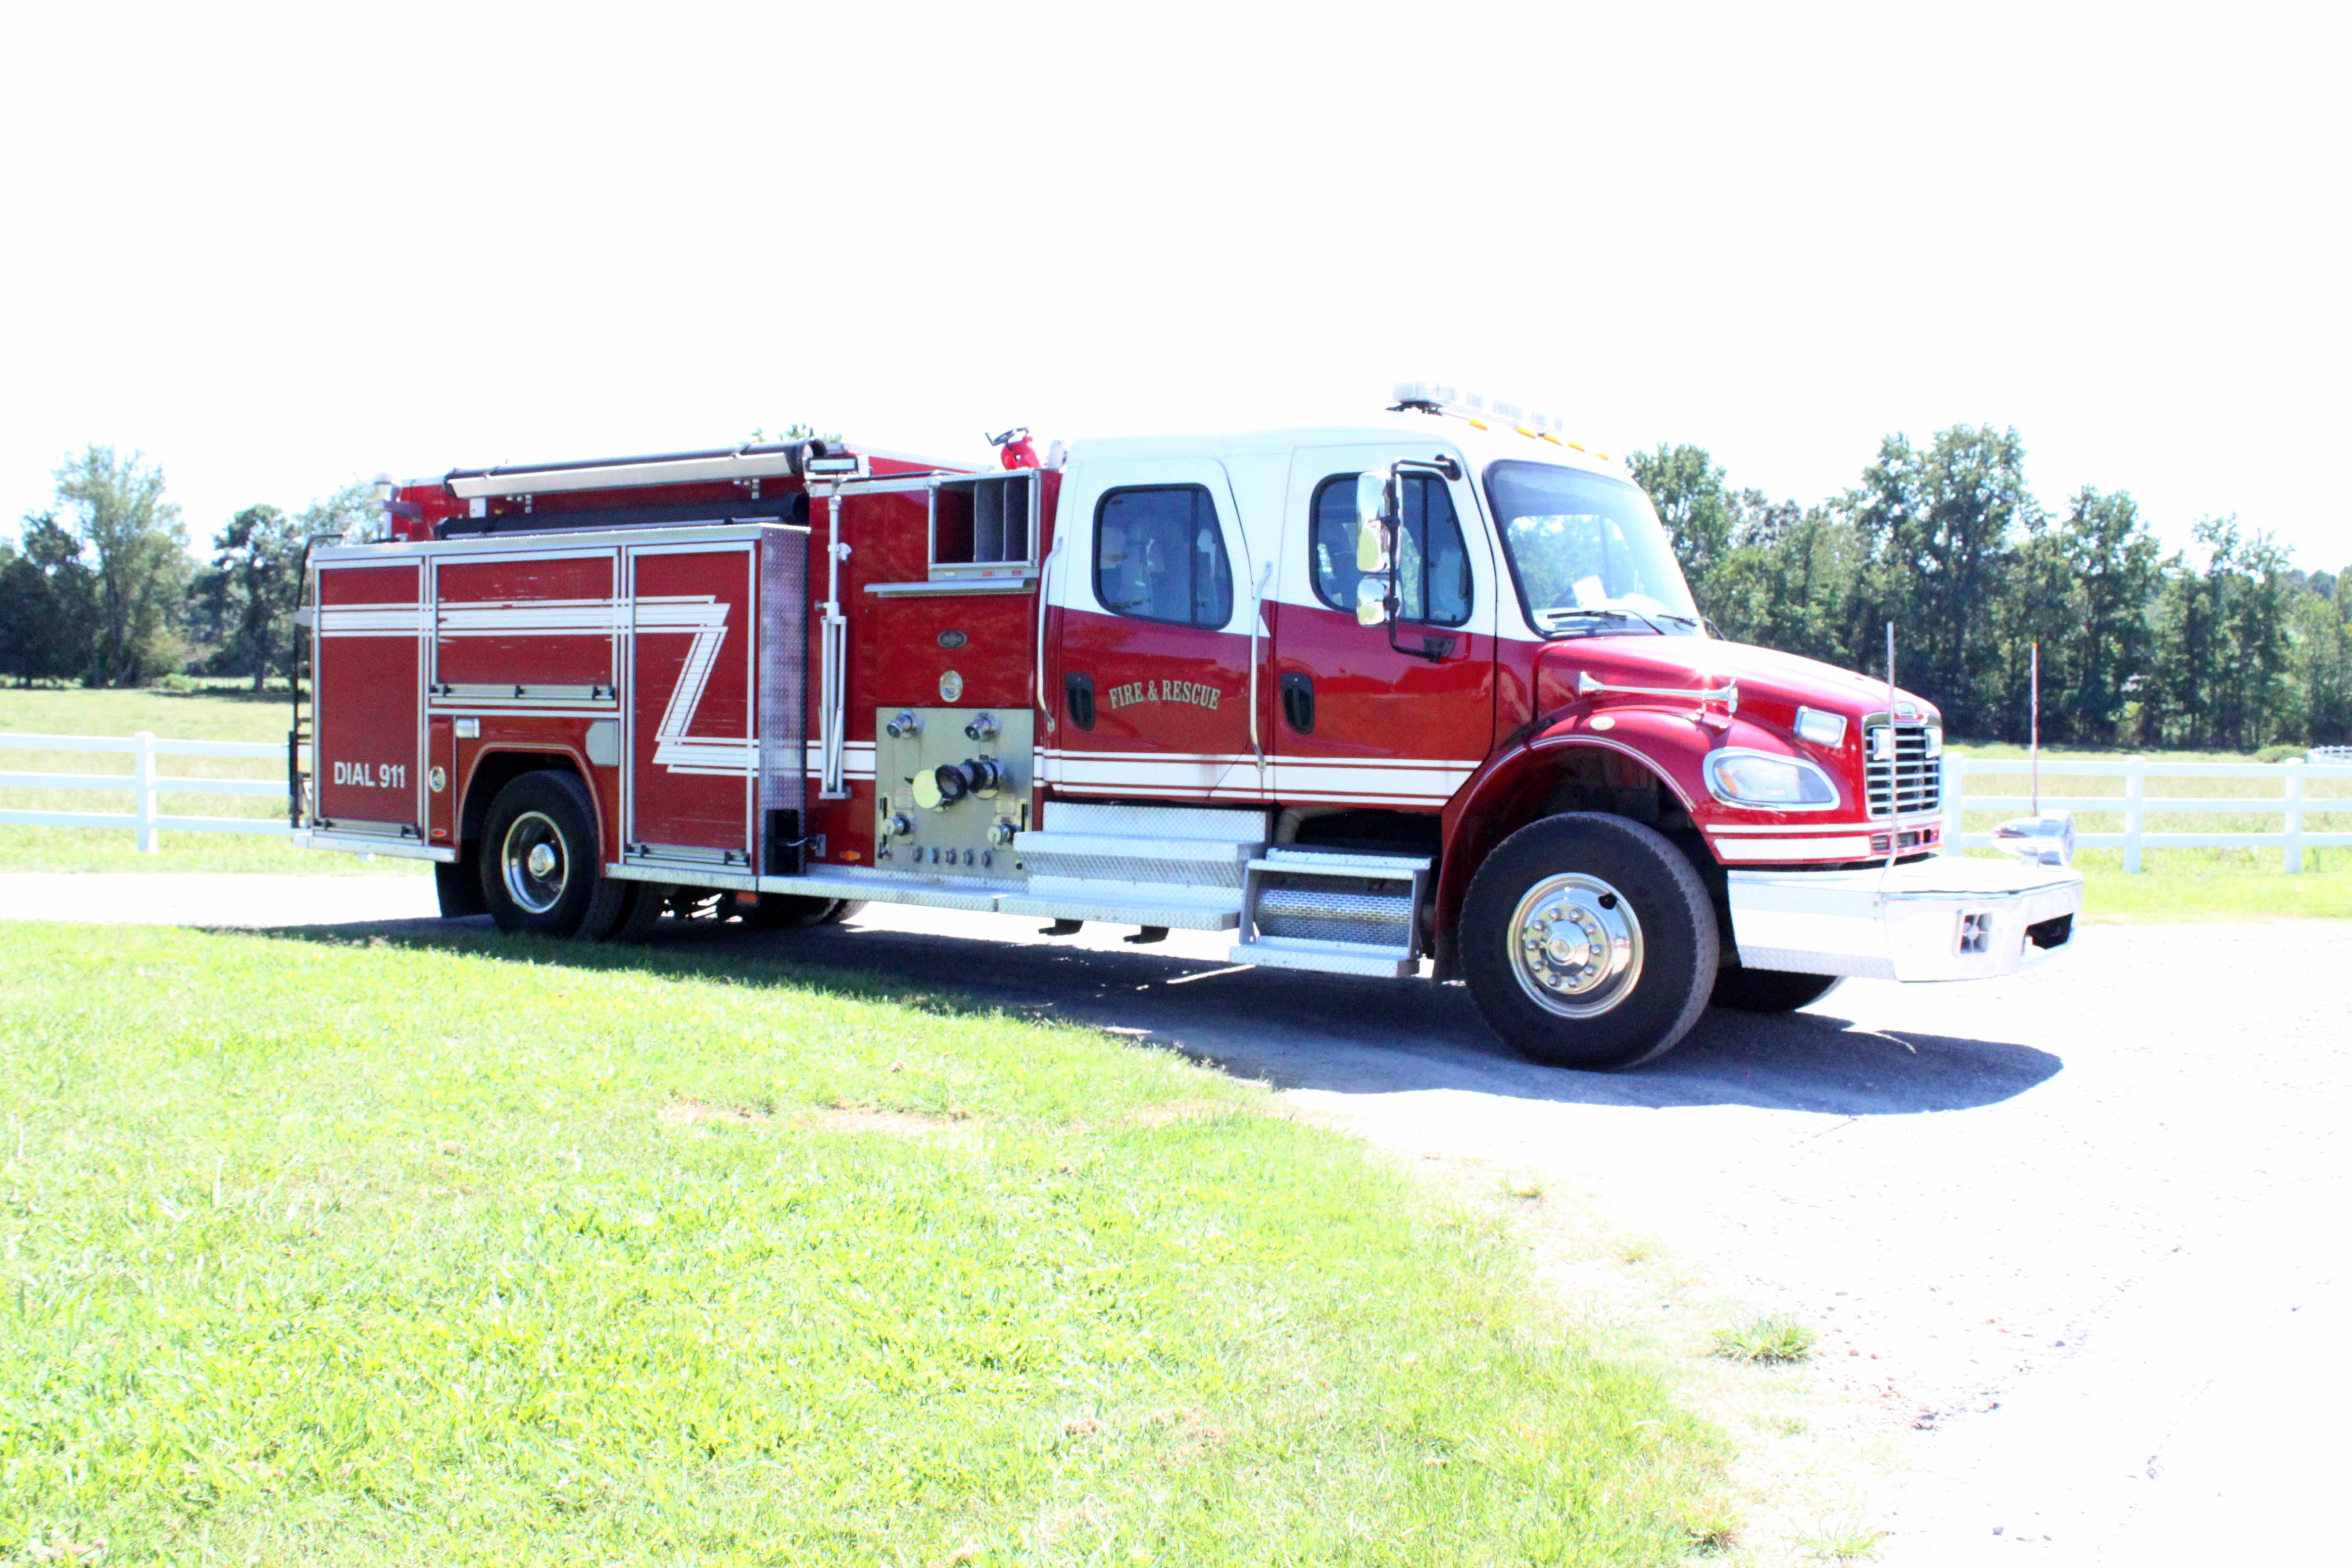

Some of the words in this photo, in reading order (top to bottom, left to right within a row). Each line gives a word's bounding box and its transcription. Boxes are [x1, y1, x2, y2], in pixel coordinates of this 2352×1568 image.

[1109, 682, 1144, 709] FIRE
[1148, 680, 1159, 701] &
[1162, 680, 1221, 710] RESCUE
[334, 761, 376, 786] DIAL
[379, 764, 406, 788] 911
